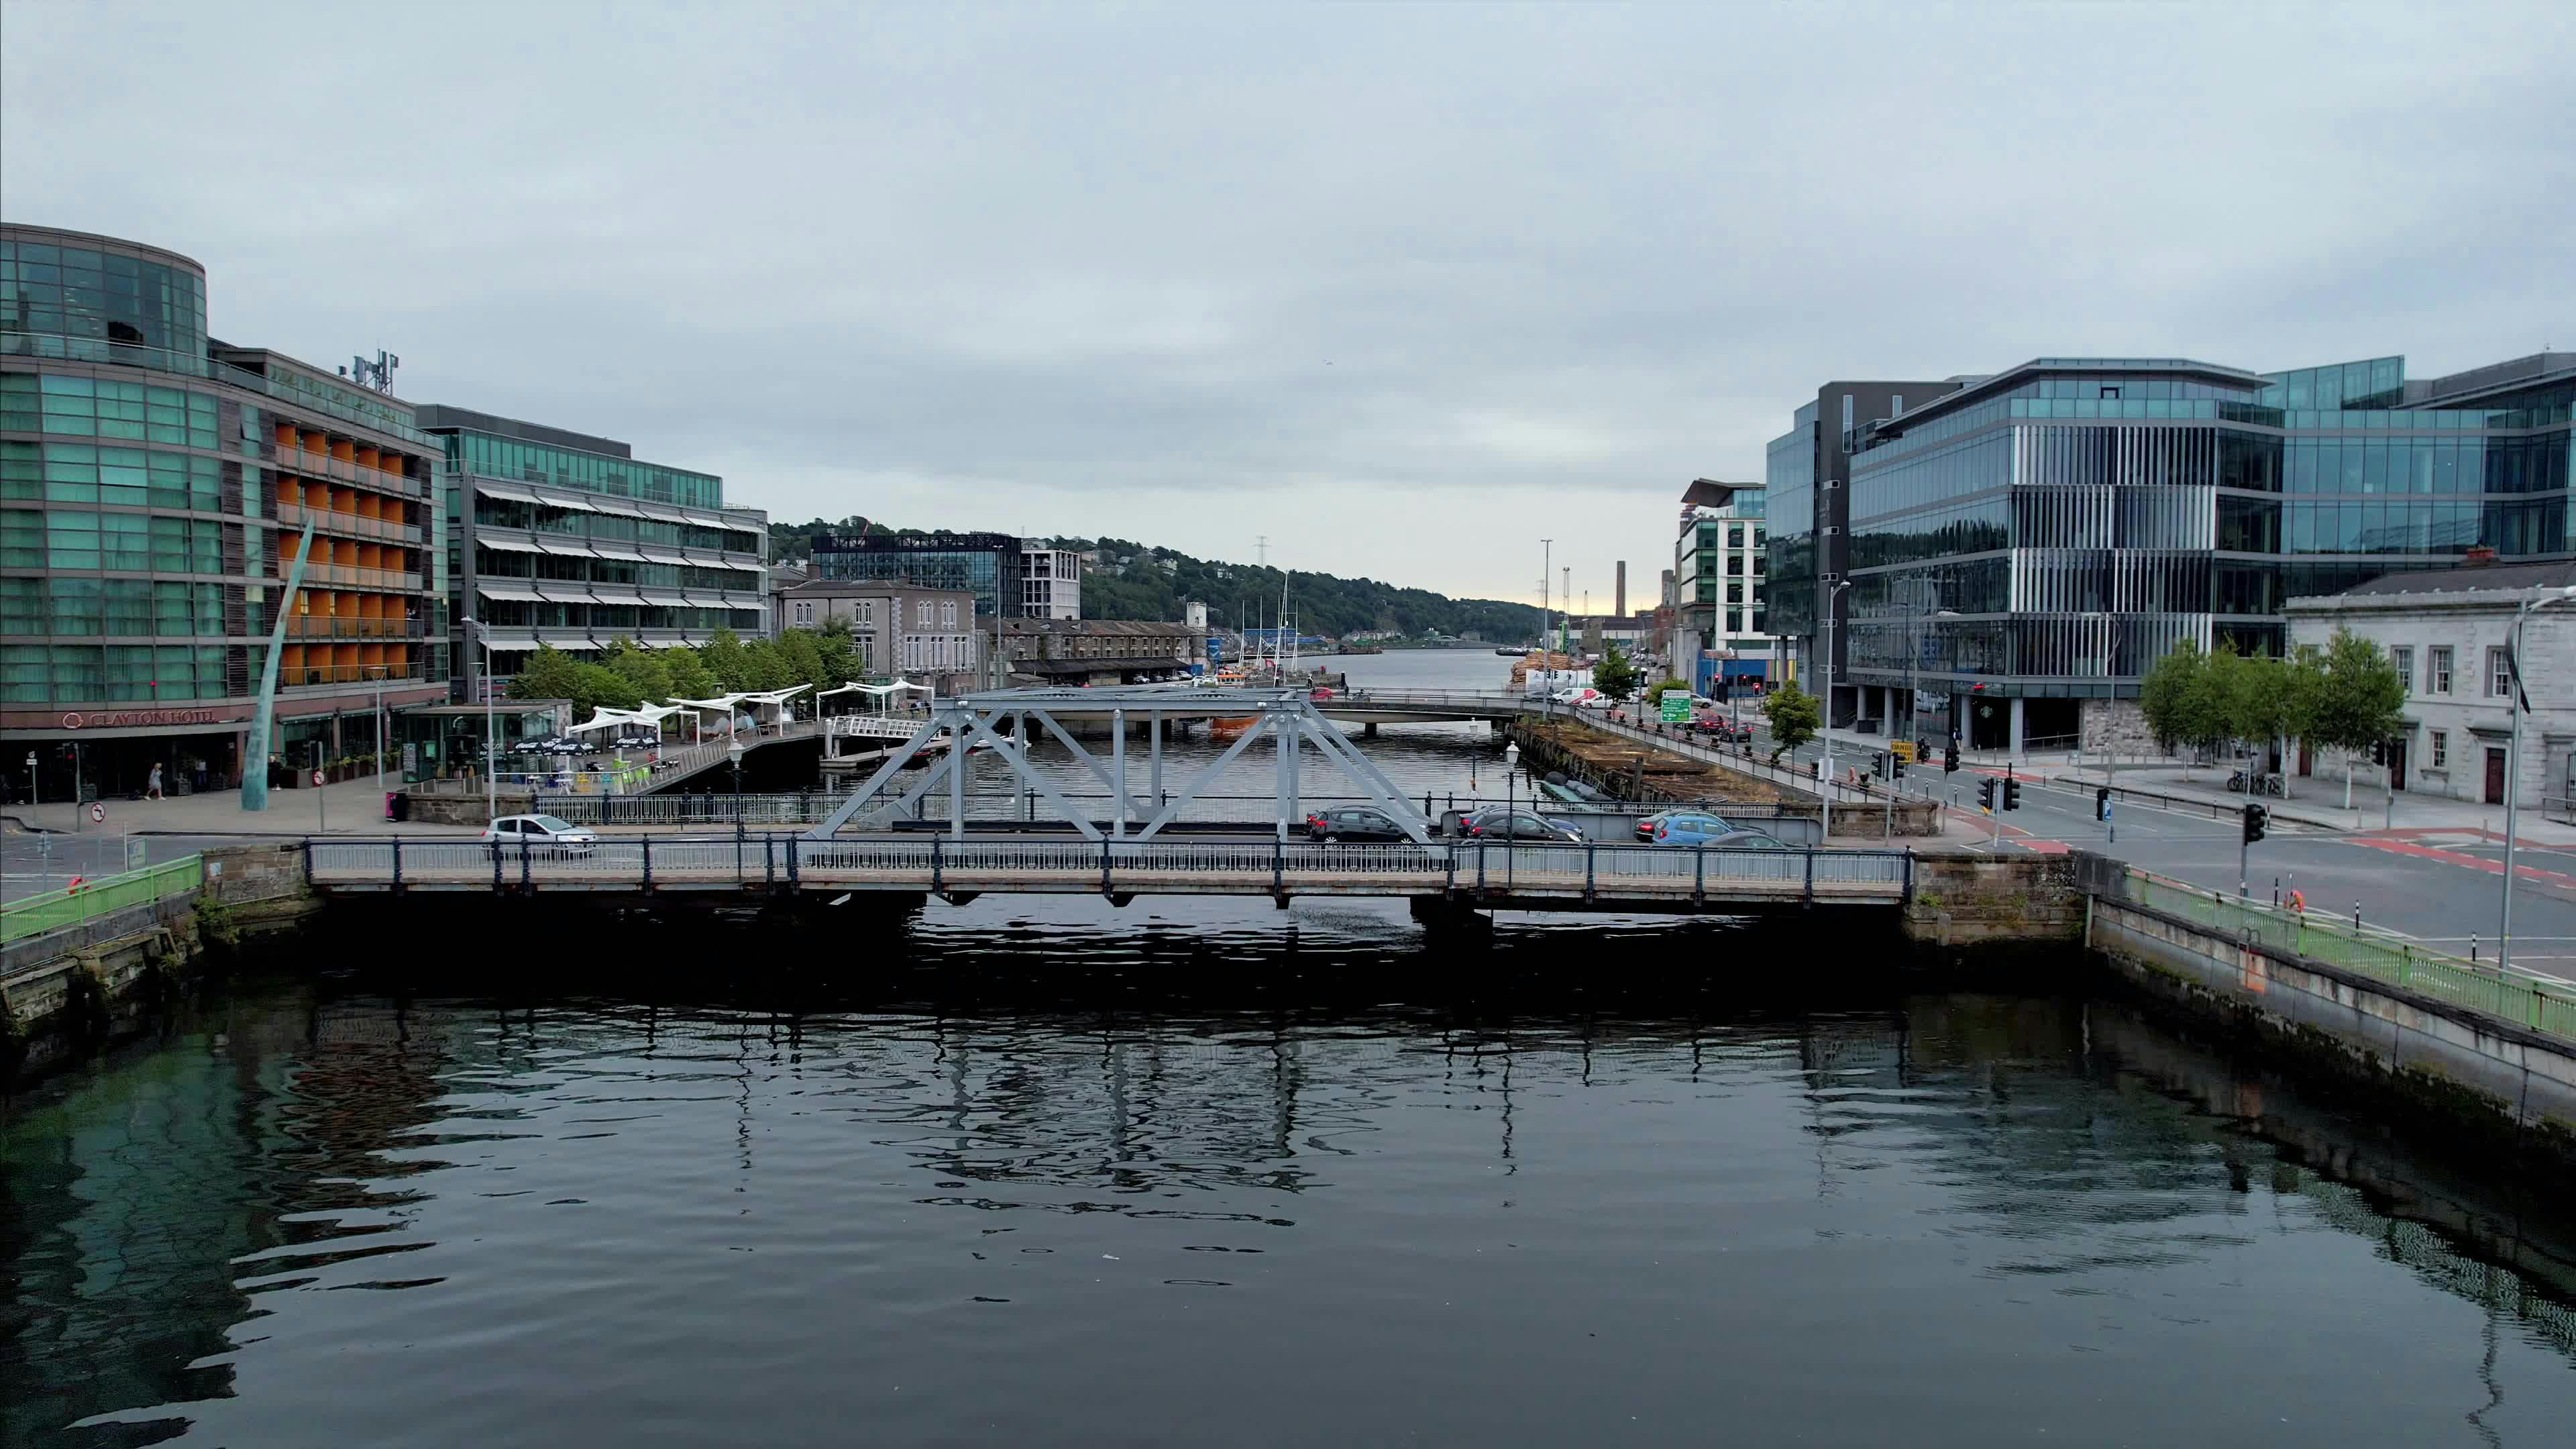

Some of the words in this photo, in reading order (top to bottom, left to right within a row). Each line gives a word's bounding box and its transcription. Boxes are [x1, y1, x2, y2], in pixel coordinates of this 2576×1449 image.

[91, 712, 166, 726] CLAYTON
[168, 710, 215, 723] HOTEL
[2104, 802, 2110, 815] P
